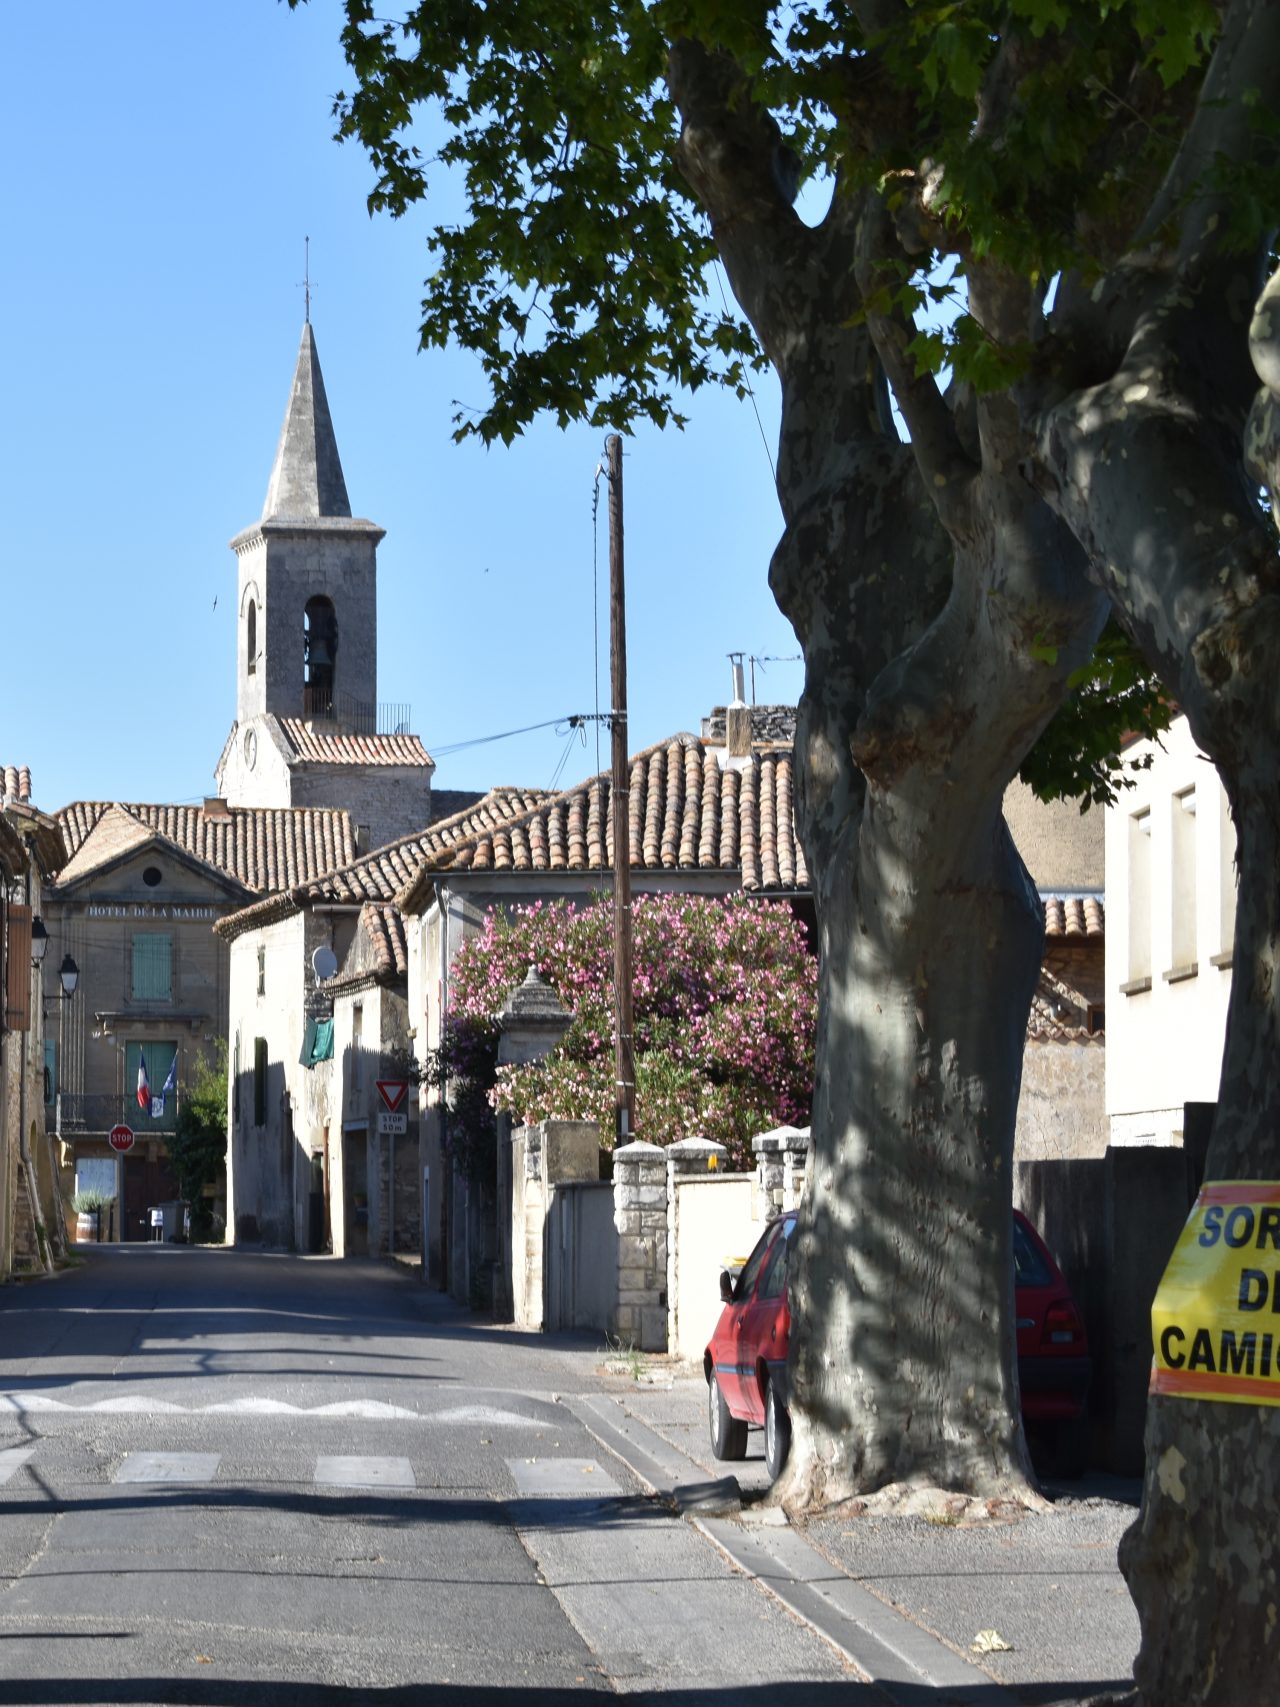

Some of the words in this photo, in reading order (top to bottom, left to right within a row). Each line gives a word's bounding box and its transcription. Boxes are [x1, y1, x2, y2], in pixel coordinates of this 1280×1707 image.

[134, 906, 147, 917] DE
[152, 907, 168, 918] LA
[172, 907, 215, 918] MAIRIE
[383, 1115, 403, 1123] STOP
[112, 1134, 132, 1142] STOP
[1160, 1326, 1280, 1376] CAMI
